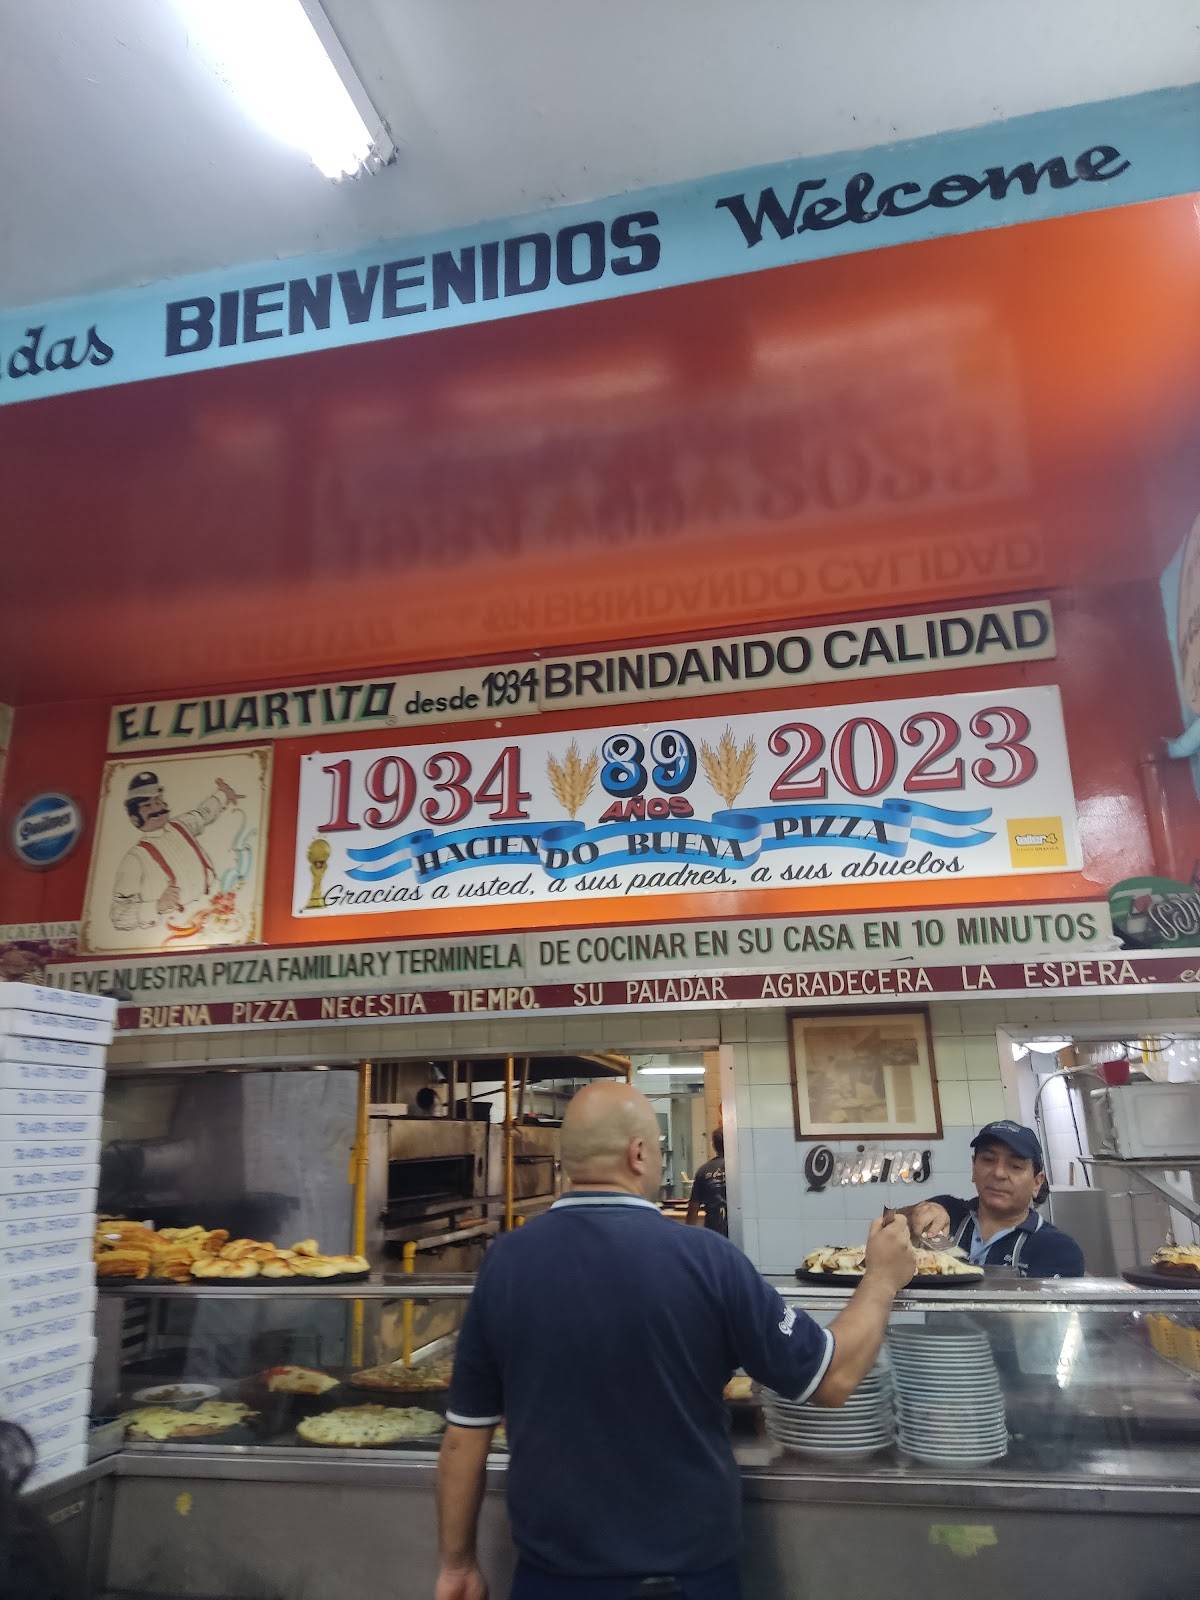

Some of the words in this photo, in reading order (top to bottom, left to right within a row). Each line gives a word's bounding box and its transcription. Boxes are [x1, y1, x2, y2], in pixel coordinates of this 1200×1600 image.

[165, 210, 661, 356] BIENVENIDOS
[715, 144, 1131, 248] Welcome
[116, 705, 162, 745] EL
[168, 682, 397, 739] CUARTITO
[404, 685, 480, 715] desde
[481, 667, 539, 707] 1934
[544, 636, 811, 699] BRINDANDO
[823, 607, 1051, 666] CALIDAD
[317, 745, 531, 832] 1934
[600, 729, 697, 798] 89
[767, 705, 1038, 800] 2023
[598, 794, 695, 824] AÑOS
[626, 831, 745, 862] BUENA
[773, 815, 888, 844] PIZZA
[322, 881, 424, 907] Gracias
[432, 886, 451, 899] a
[457, 873, 535, 898] usted,
[548, 878, 567, 893] a
[575, 873, 622, 891] sus
[625, 863, 737, 895] padres,
[750, 866, 772, 882] a
[780, 862, 833, 881] sus
[841, 851, 965, 878] abuelos
[113, 961, 208, 991] NUESTRA
[212, 957, 273, 985] PIZZA
[540, 939, 570, 965] DE
[577, 931, 688, 964] COCINAR
[694, 929, 729, 957] EN
[737, 927, 773, 954] SU
[783, 921, 854, 953] CASA
[864, 920, 900, 948] EN
[911, 918, 945, 946] 10
[956, 912, 1096, 945] MINUTOS
[139, 1004, 210, 1028] BUENA
[232, 998, 298, 1023] PIZZA
[320, 992, 427, 1019] NECESITA
[573, 983, 604, 1006] SU
[626, 976, 728, 1004] PALADAR
[761, 967, 934, 999] AGRADECERA
[960, 965, 997, 990] LA
